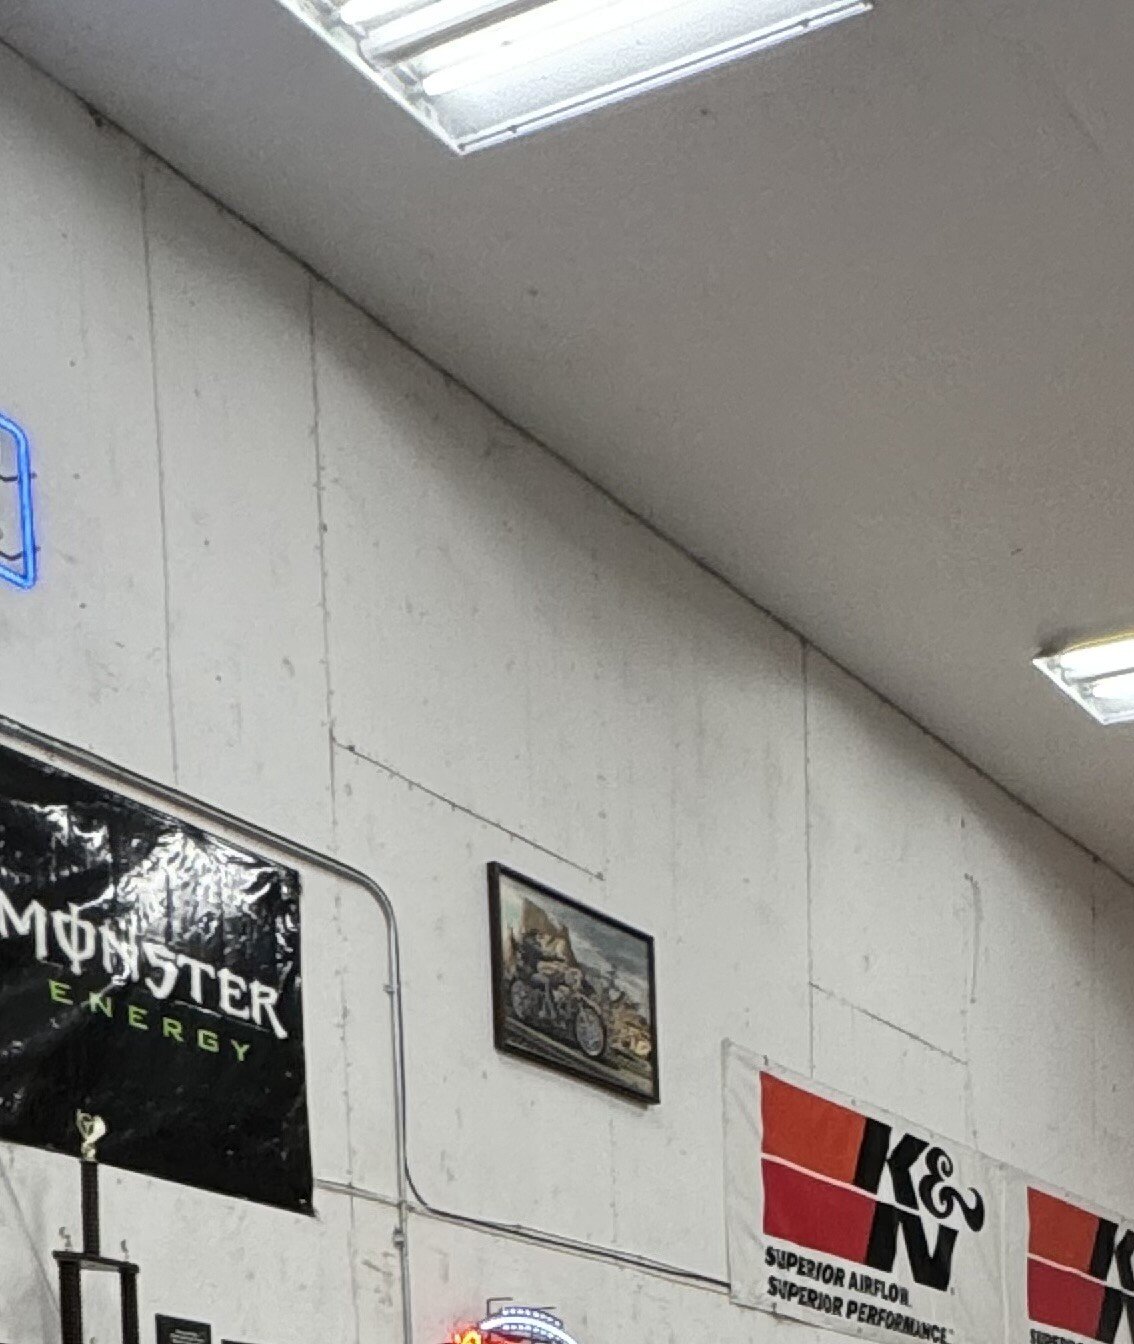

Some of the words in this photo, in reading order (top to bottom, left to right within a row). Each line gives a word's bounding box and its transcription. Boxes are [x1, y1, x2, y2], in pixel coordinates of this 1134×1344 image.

[48, 978, 250, 1062] ENERGY
[764, 1246, 845, 1288] SUPERIOR
[766, 1275, 843, 1317] SUPERIOR
